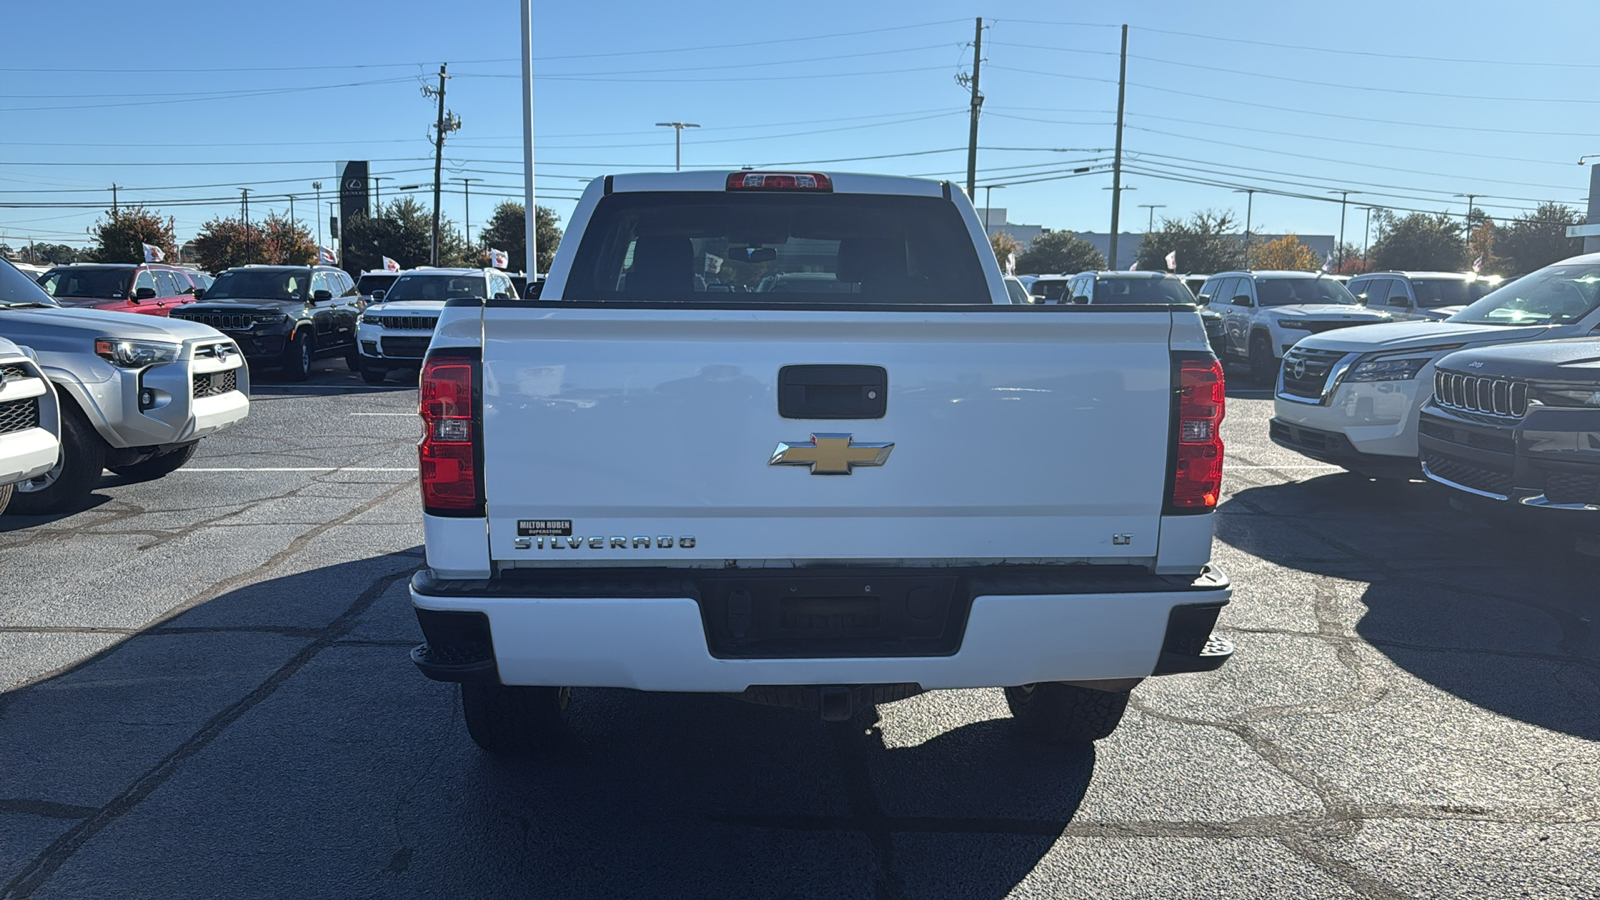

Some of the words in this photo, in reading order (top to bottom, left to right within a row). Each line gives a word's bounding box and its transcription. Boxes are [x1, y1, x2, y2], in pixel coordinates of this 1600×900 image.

[519, 521, 546, 529] MILTON
[546, 521, 570, 529] RUBEN
[514, 535, 696, 550] SILVERADO
[1113, 533, 1135, 545] LT
